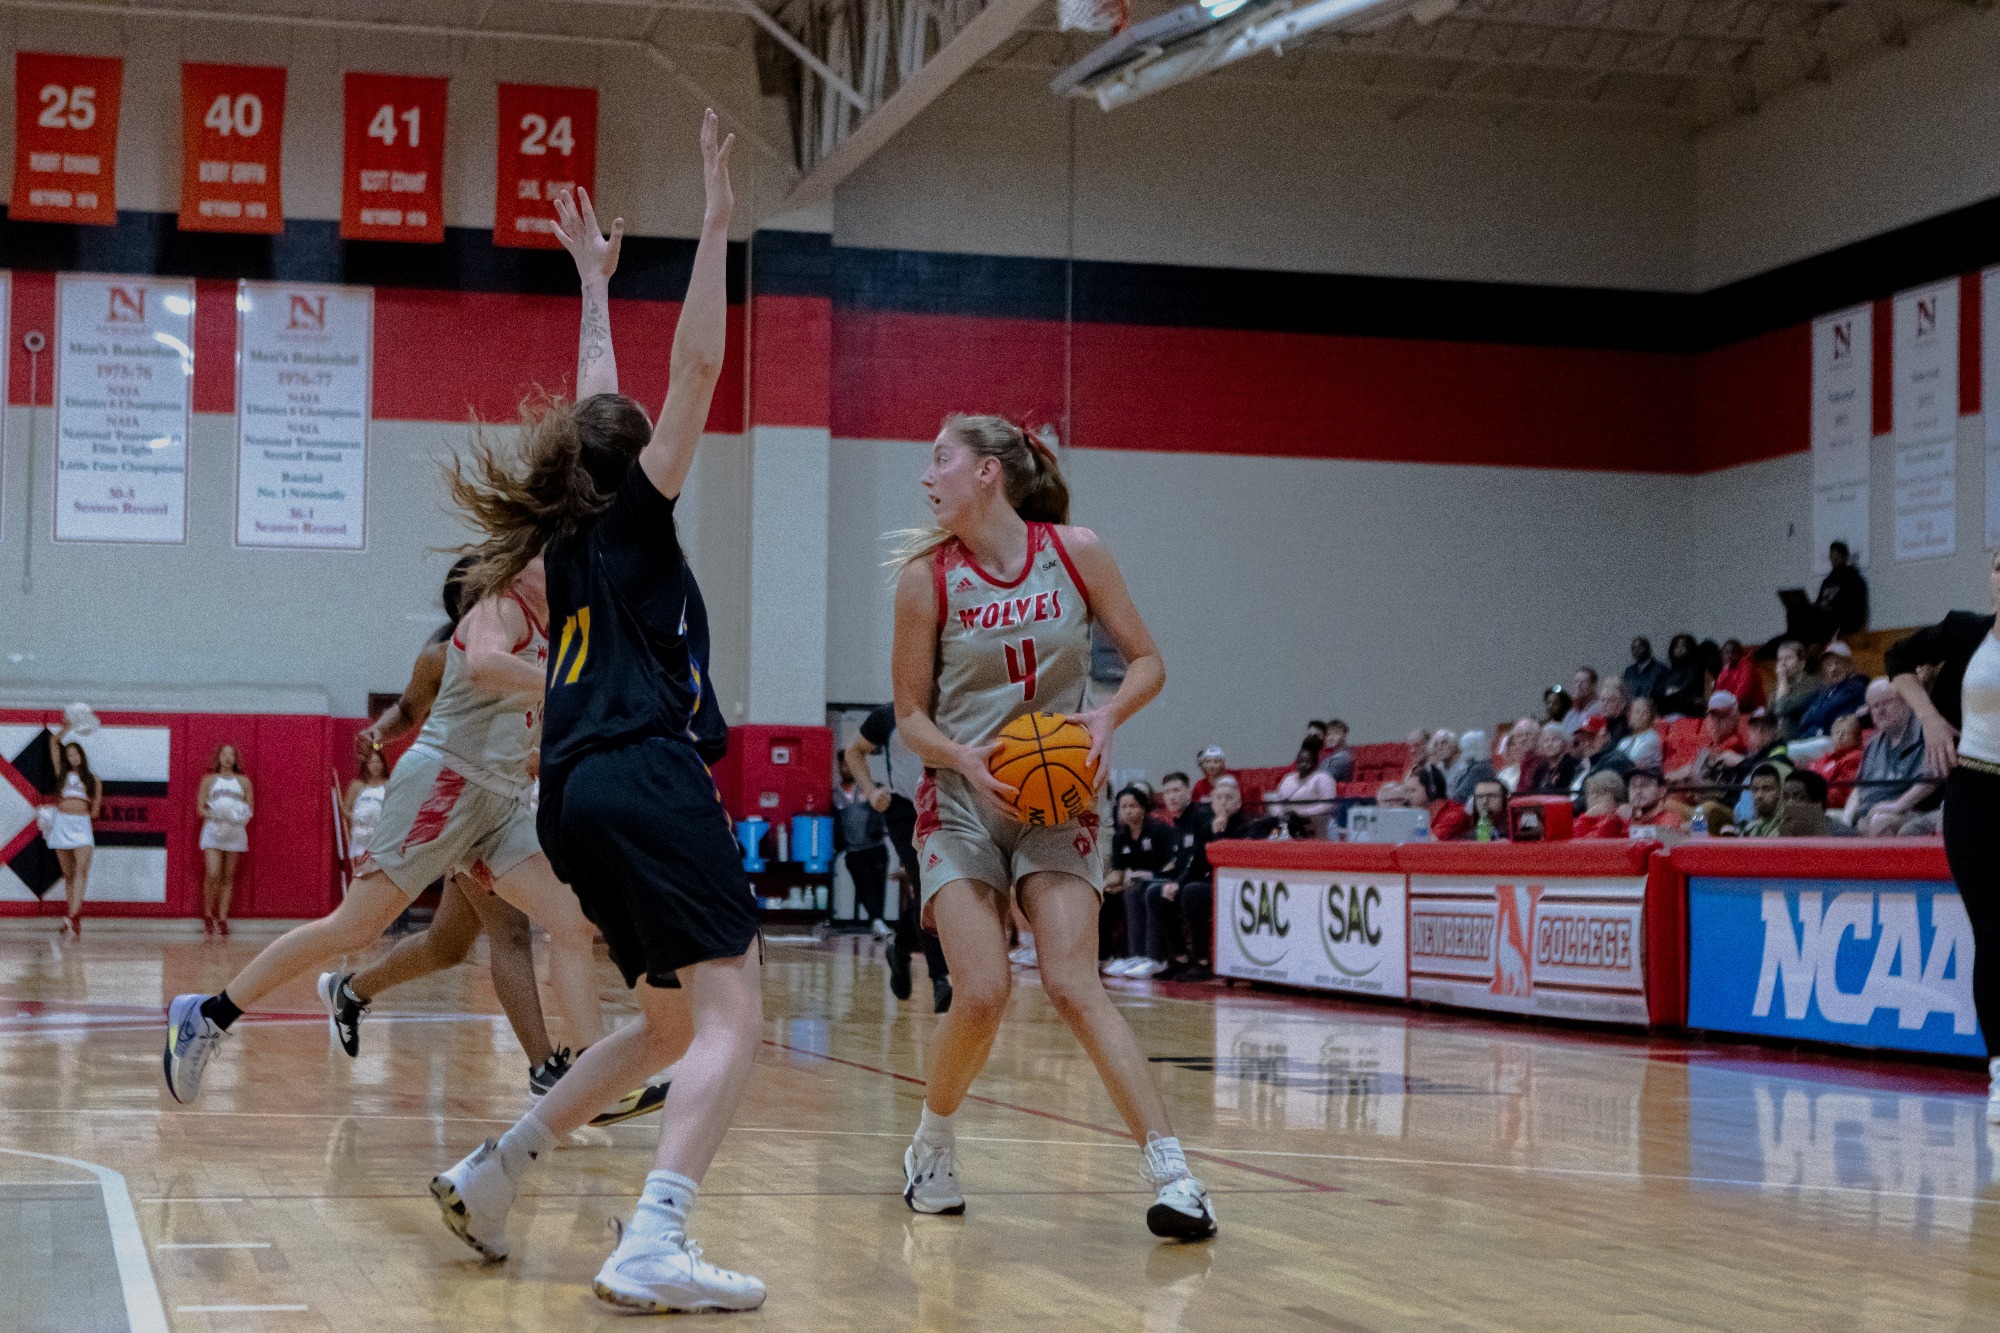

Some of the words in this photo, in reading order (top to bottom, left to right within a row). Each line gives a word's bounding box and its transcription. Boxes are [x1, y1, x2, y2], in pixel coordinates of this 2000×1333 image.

[38, 84, 97, 130] 25
[205, 93, 263, 137] 40
[367, 104, 421, 148] 41
[520, 113, 576, 157] 24
[956, 588, 1064, 631] WOLVES
[1003, 634, 1038, 702] 4
[1240, 880, 1290, 938] SAC
[1328, 883, 1383, 946] SAC
[1413, 912, 1494, 960] NEWBERRY
[1537, 915, 1633, 970] COLLEGE
[1752, 890, 1977, 1036] NCAA
